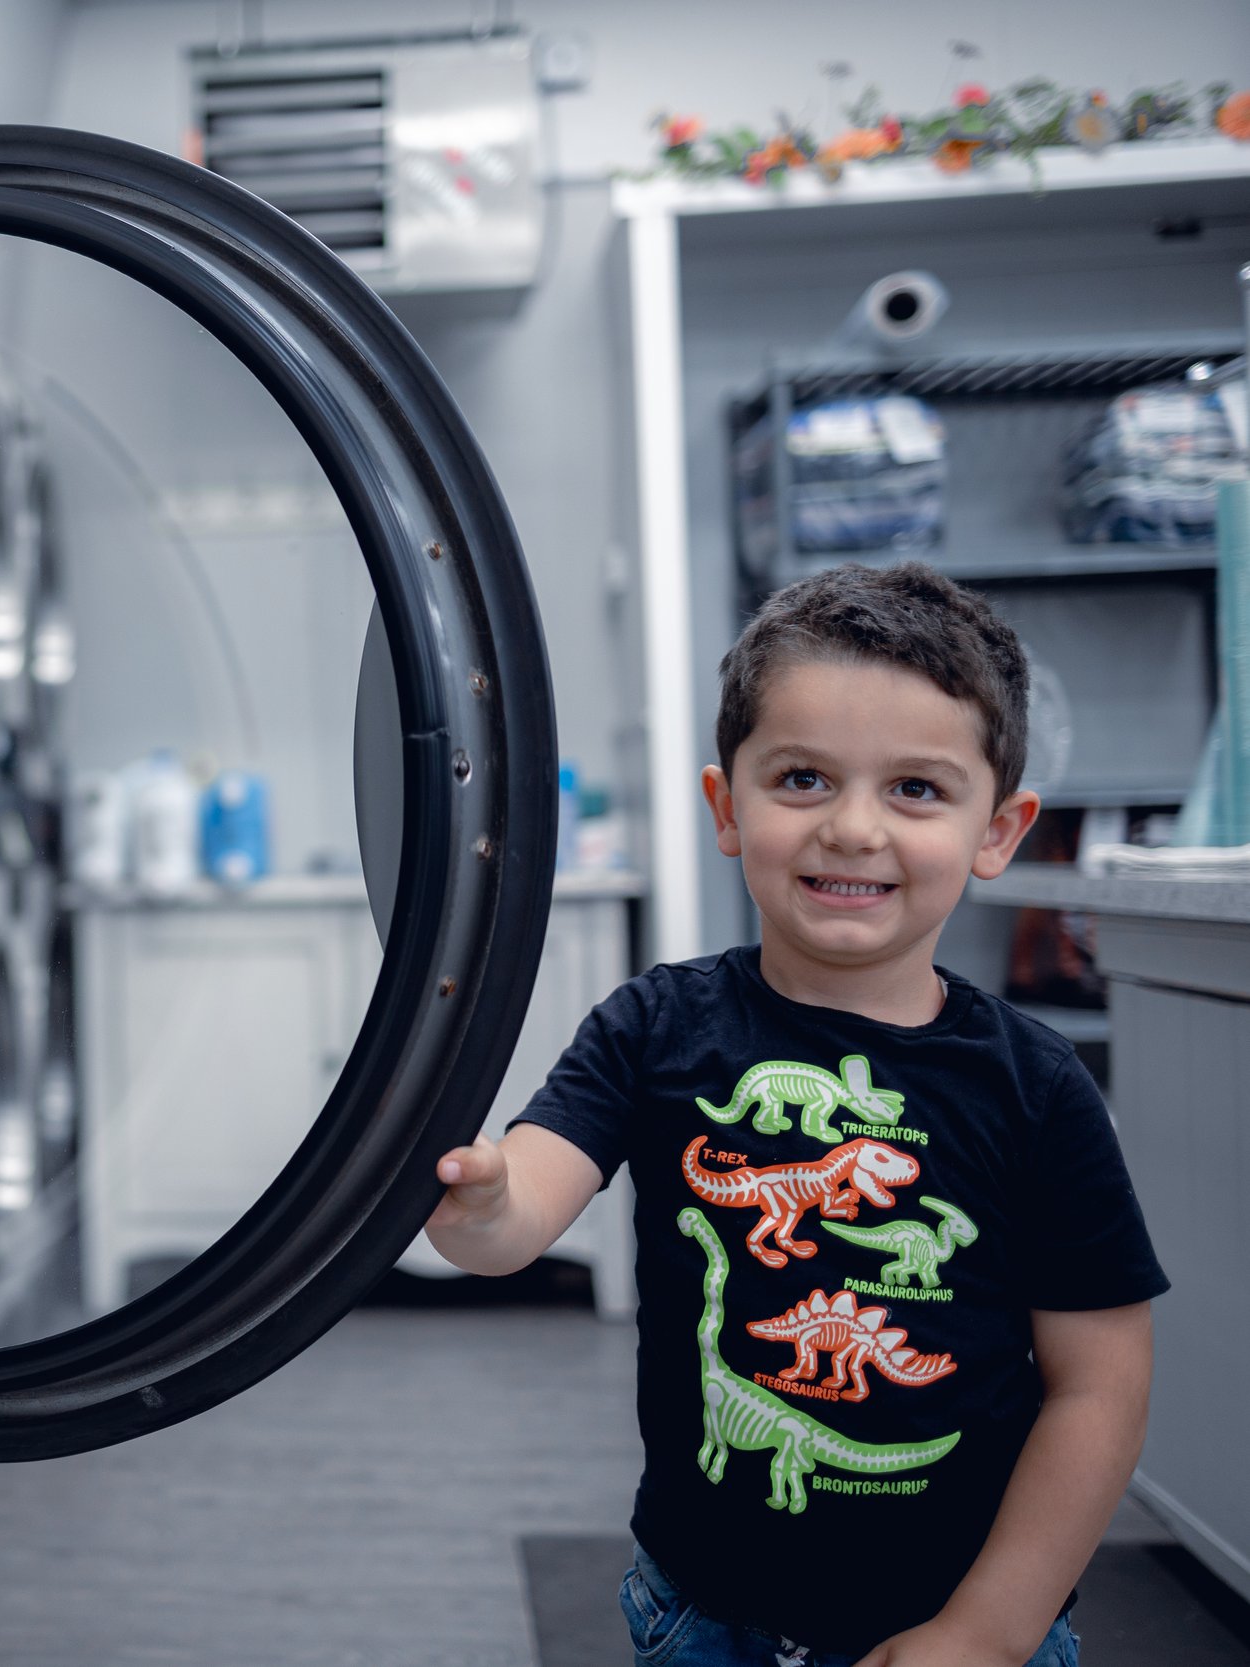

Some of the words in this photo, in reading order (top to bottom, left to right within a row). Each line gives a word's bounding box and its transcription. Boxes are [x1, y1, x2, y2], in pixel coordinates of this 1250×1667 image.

[841, 1122, 929, 1146] TRICERATOPS
[703, 1149, 749, 1166] T-REX
[843, 1277, 954, 1301] PARASAUROLOPHUS
[753, 1373, 840, 1401] STEGOSAURUS
[812, 1475, 929, 1495] BRONTOSAURUS
